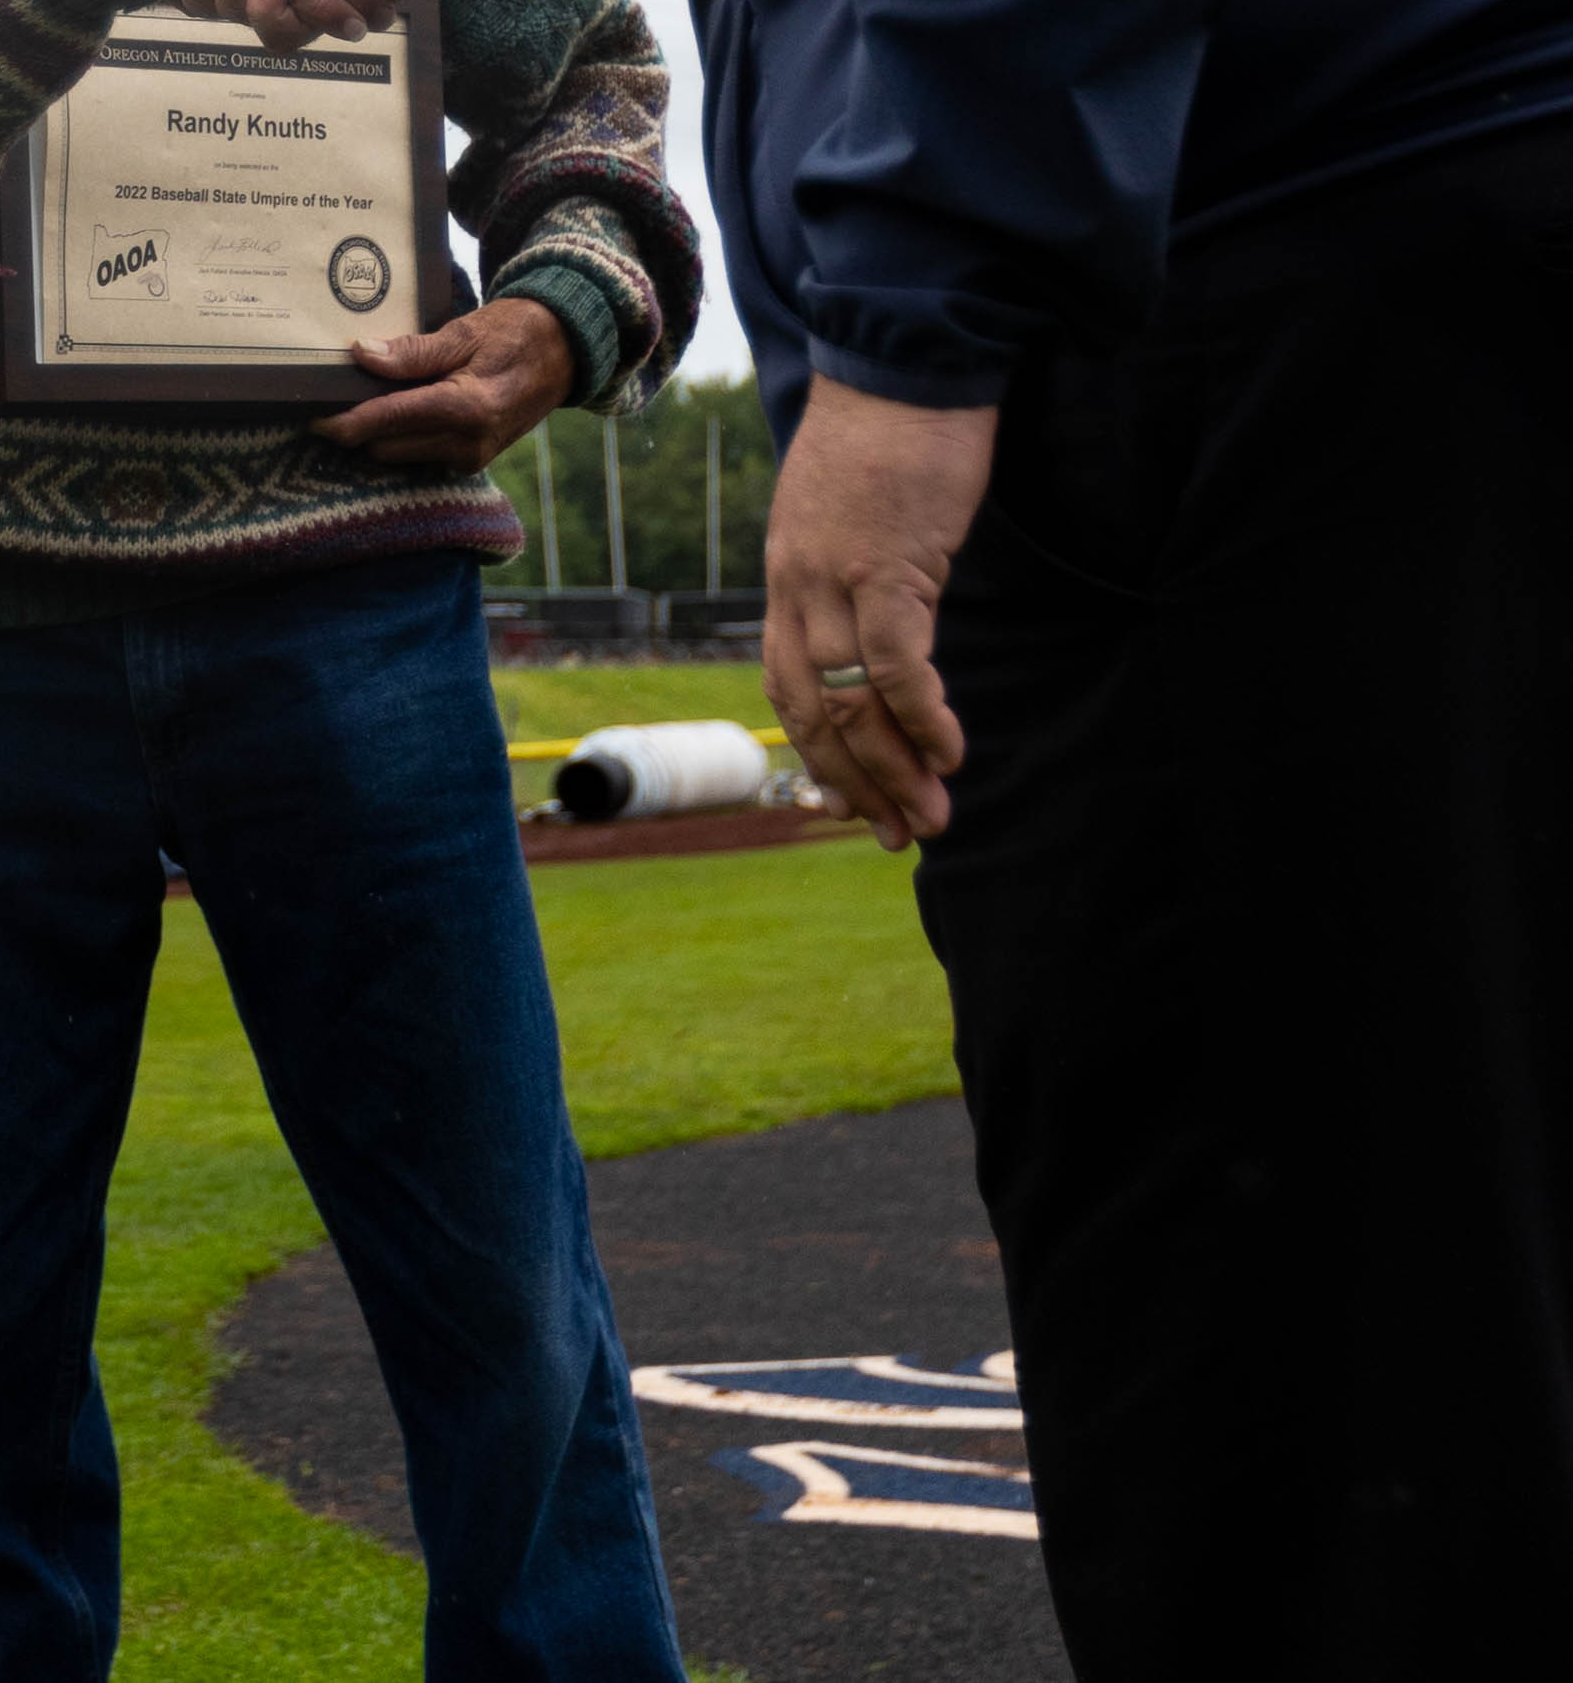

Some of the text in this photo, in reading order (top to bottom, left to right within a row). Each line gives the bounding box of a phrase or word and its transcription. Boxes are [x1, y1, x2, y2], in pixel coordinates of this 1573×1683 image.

[100, 44, 384, 76] OREGON ATHLETIC OFFICIALS ASSOCIATION
[167, 109, 327, 141] Randy Knuths
[115, 185, 373, 209] 2022 Baseball State Umpire of the Year
[97, 239, 157, 286] OAOA
